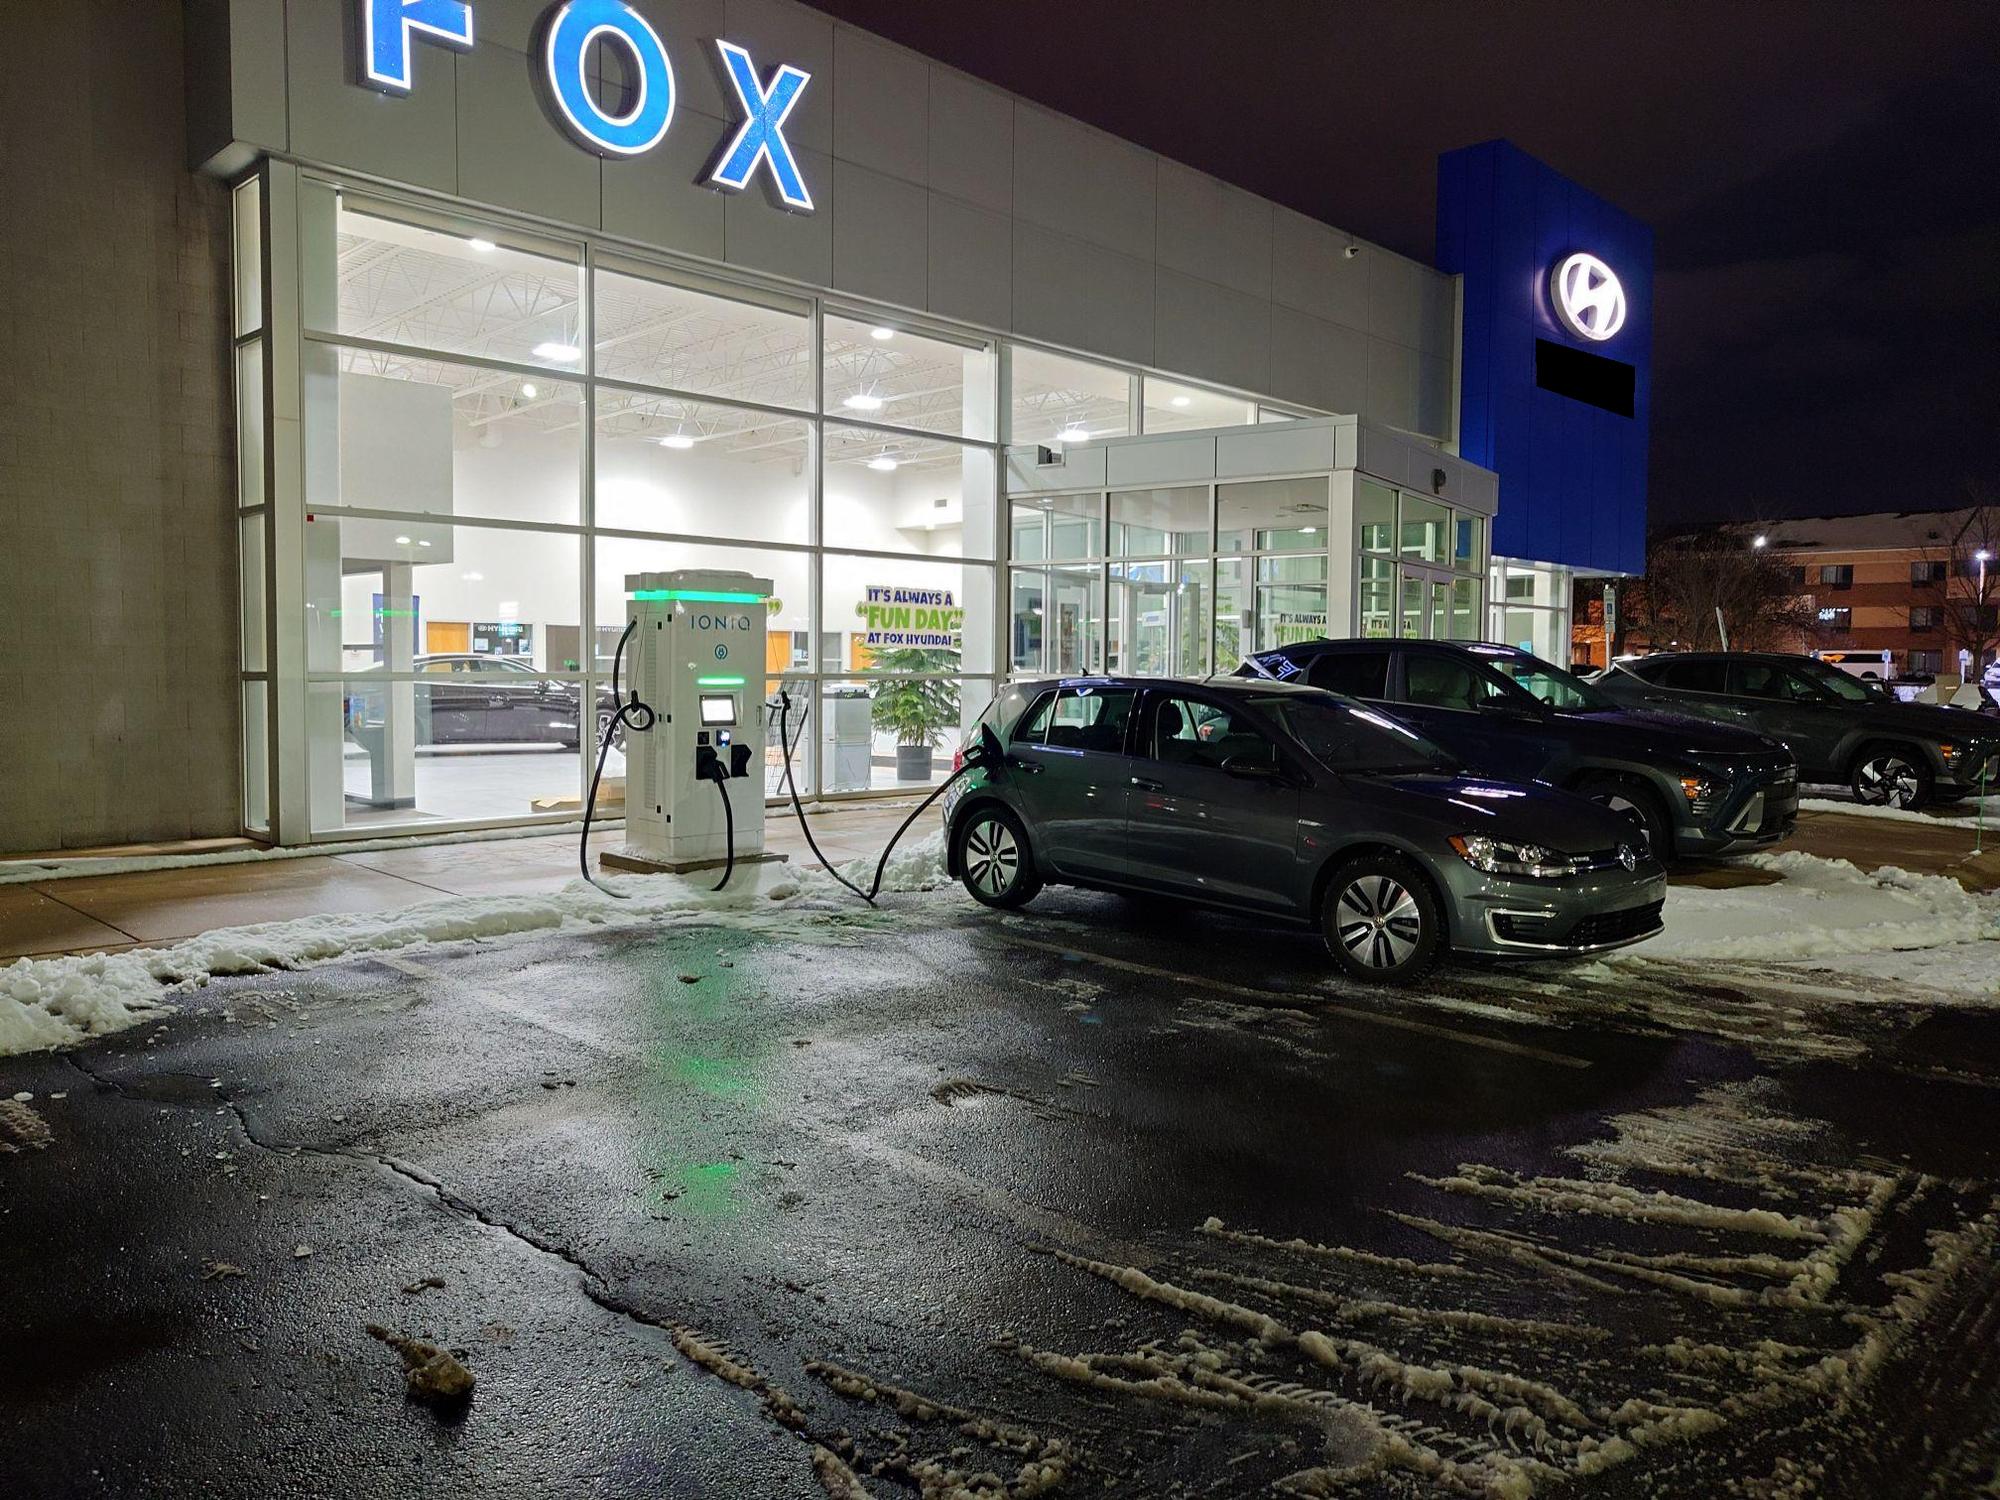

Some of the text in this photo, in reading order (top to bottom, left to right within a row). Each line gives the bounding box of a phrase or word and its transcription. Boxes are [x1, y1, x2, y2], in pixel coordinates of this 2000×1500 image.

[366, 0, 814, 210] FOX
[868, 588, 952, 606] IT'S ALWAYS A
[691, 615, 750, 631] IONIQ
[1280, 613, 1293, 624] IT'S
[1294, 613, 1321, 624] ALWAYS
[867, 632, 952, 646] AT FOX HYUNDAI
